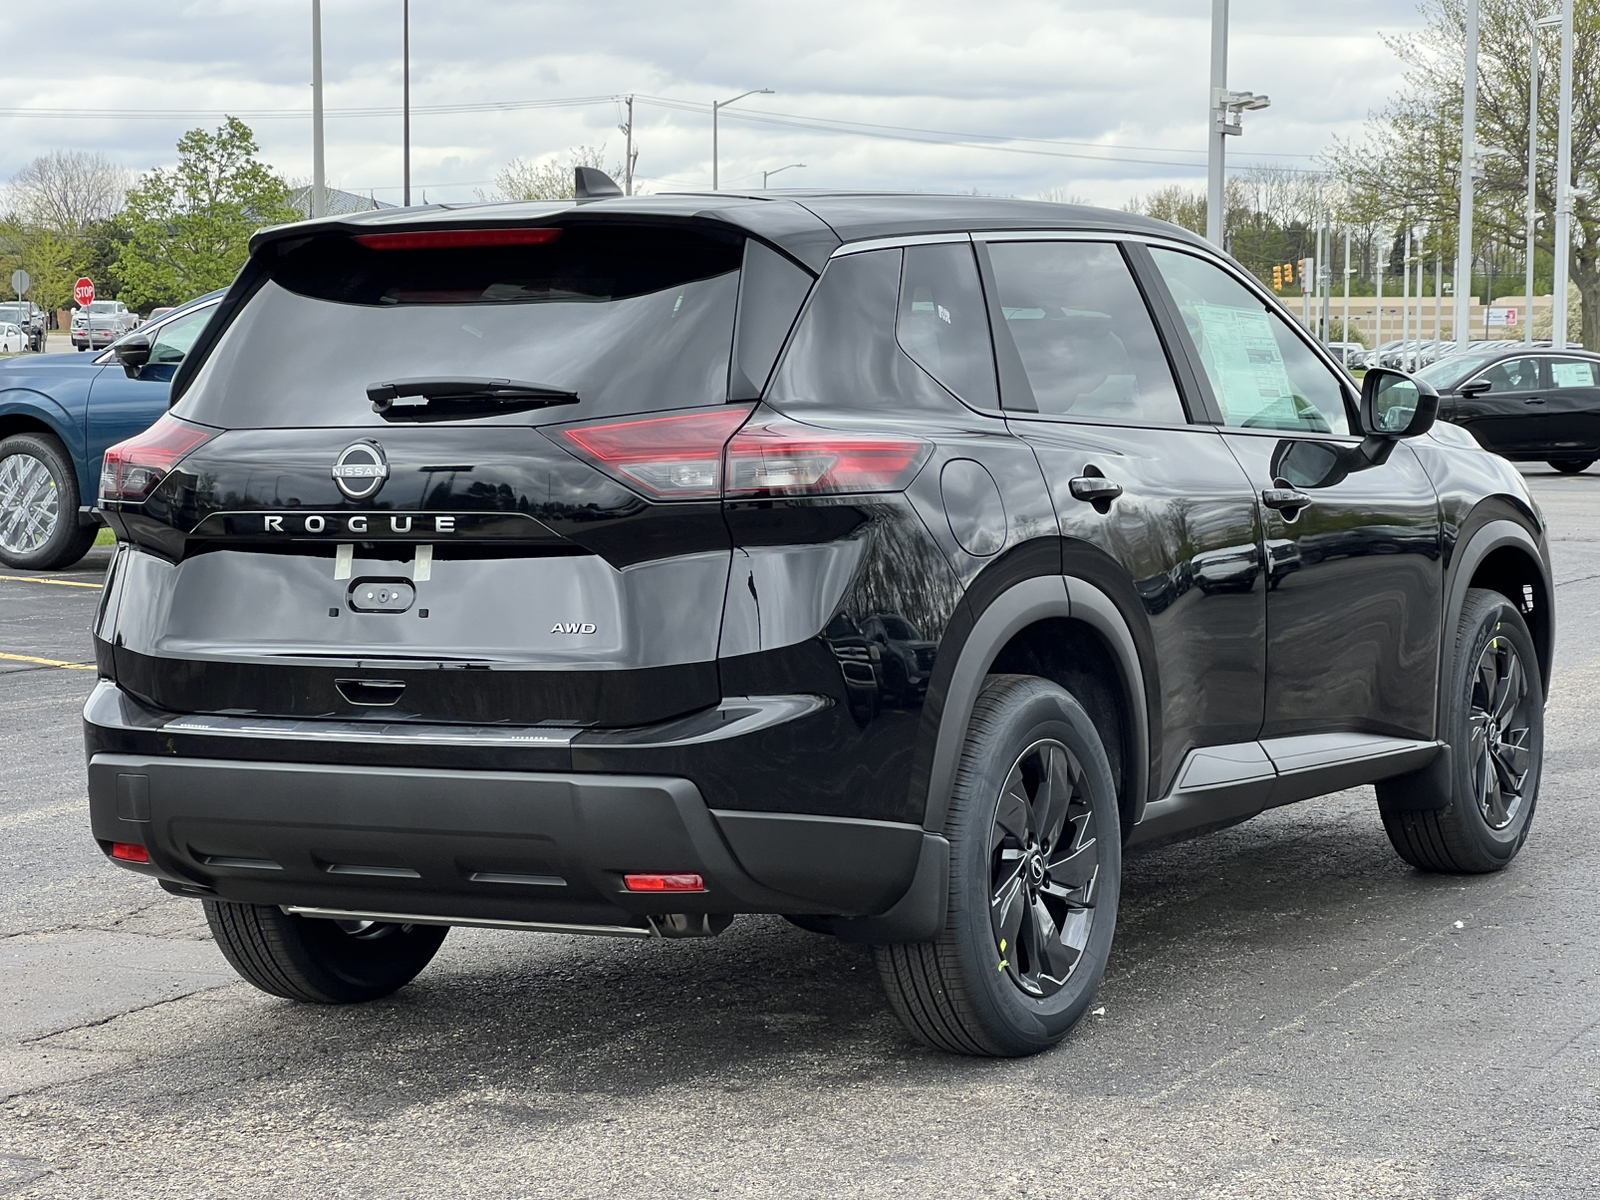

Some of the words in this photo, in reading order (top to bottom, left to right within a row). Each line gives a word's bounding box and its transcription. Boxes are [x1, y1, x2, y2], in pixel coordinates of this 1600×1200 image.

[76, 286, 93, 298] STOP
[332, 467, 384, 476] NISSAN
[264, 515, 456, 533] ROGUE
[550, 622, 597, 635] AWD
